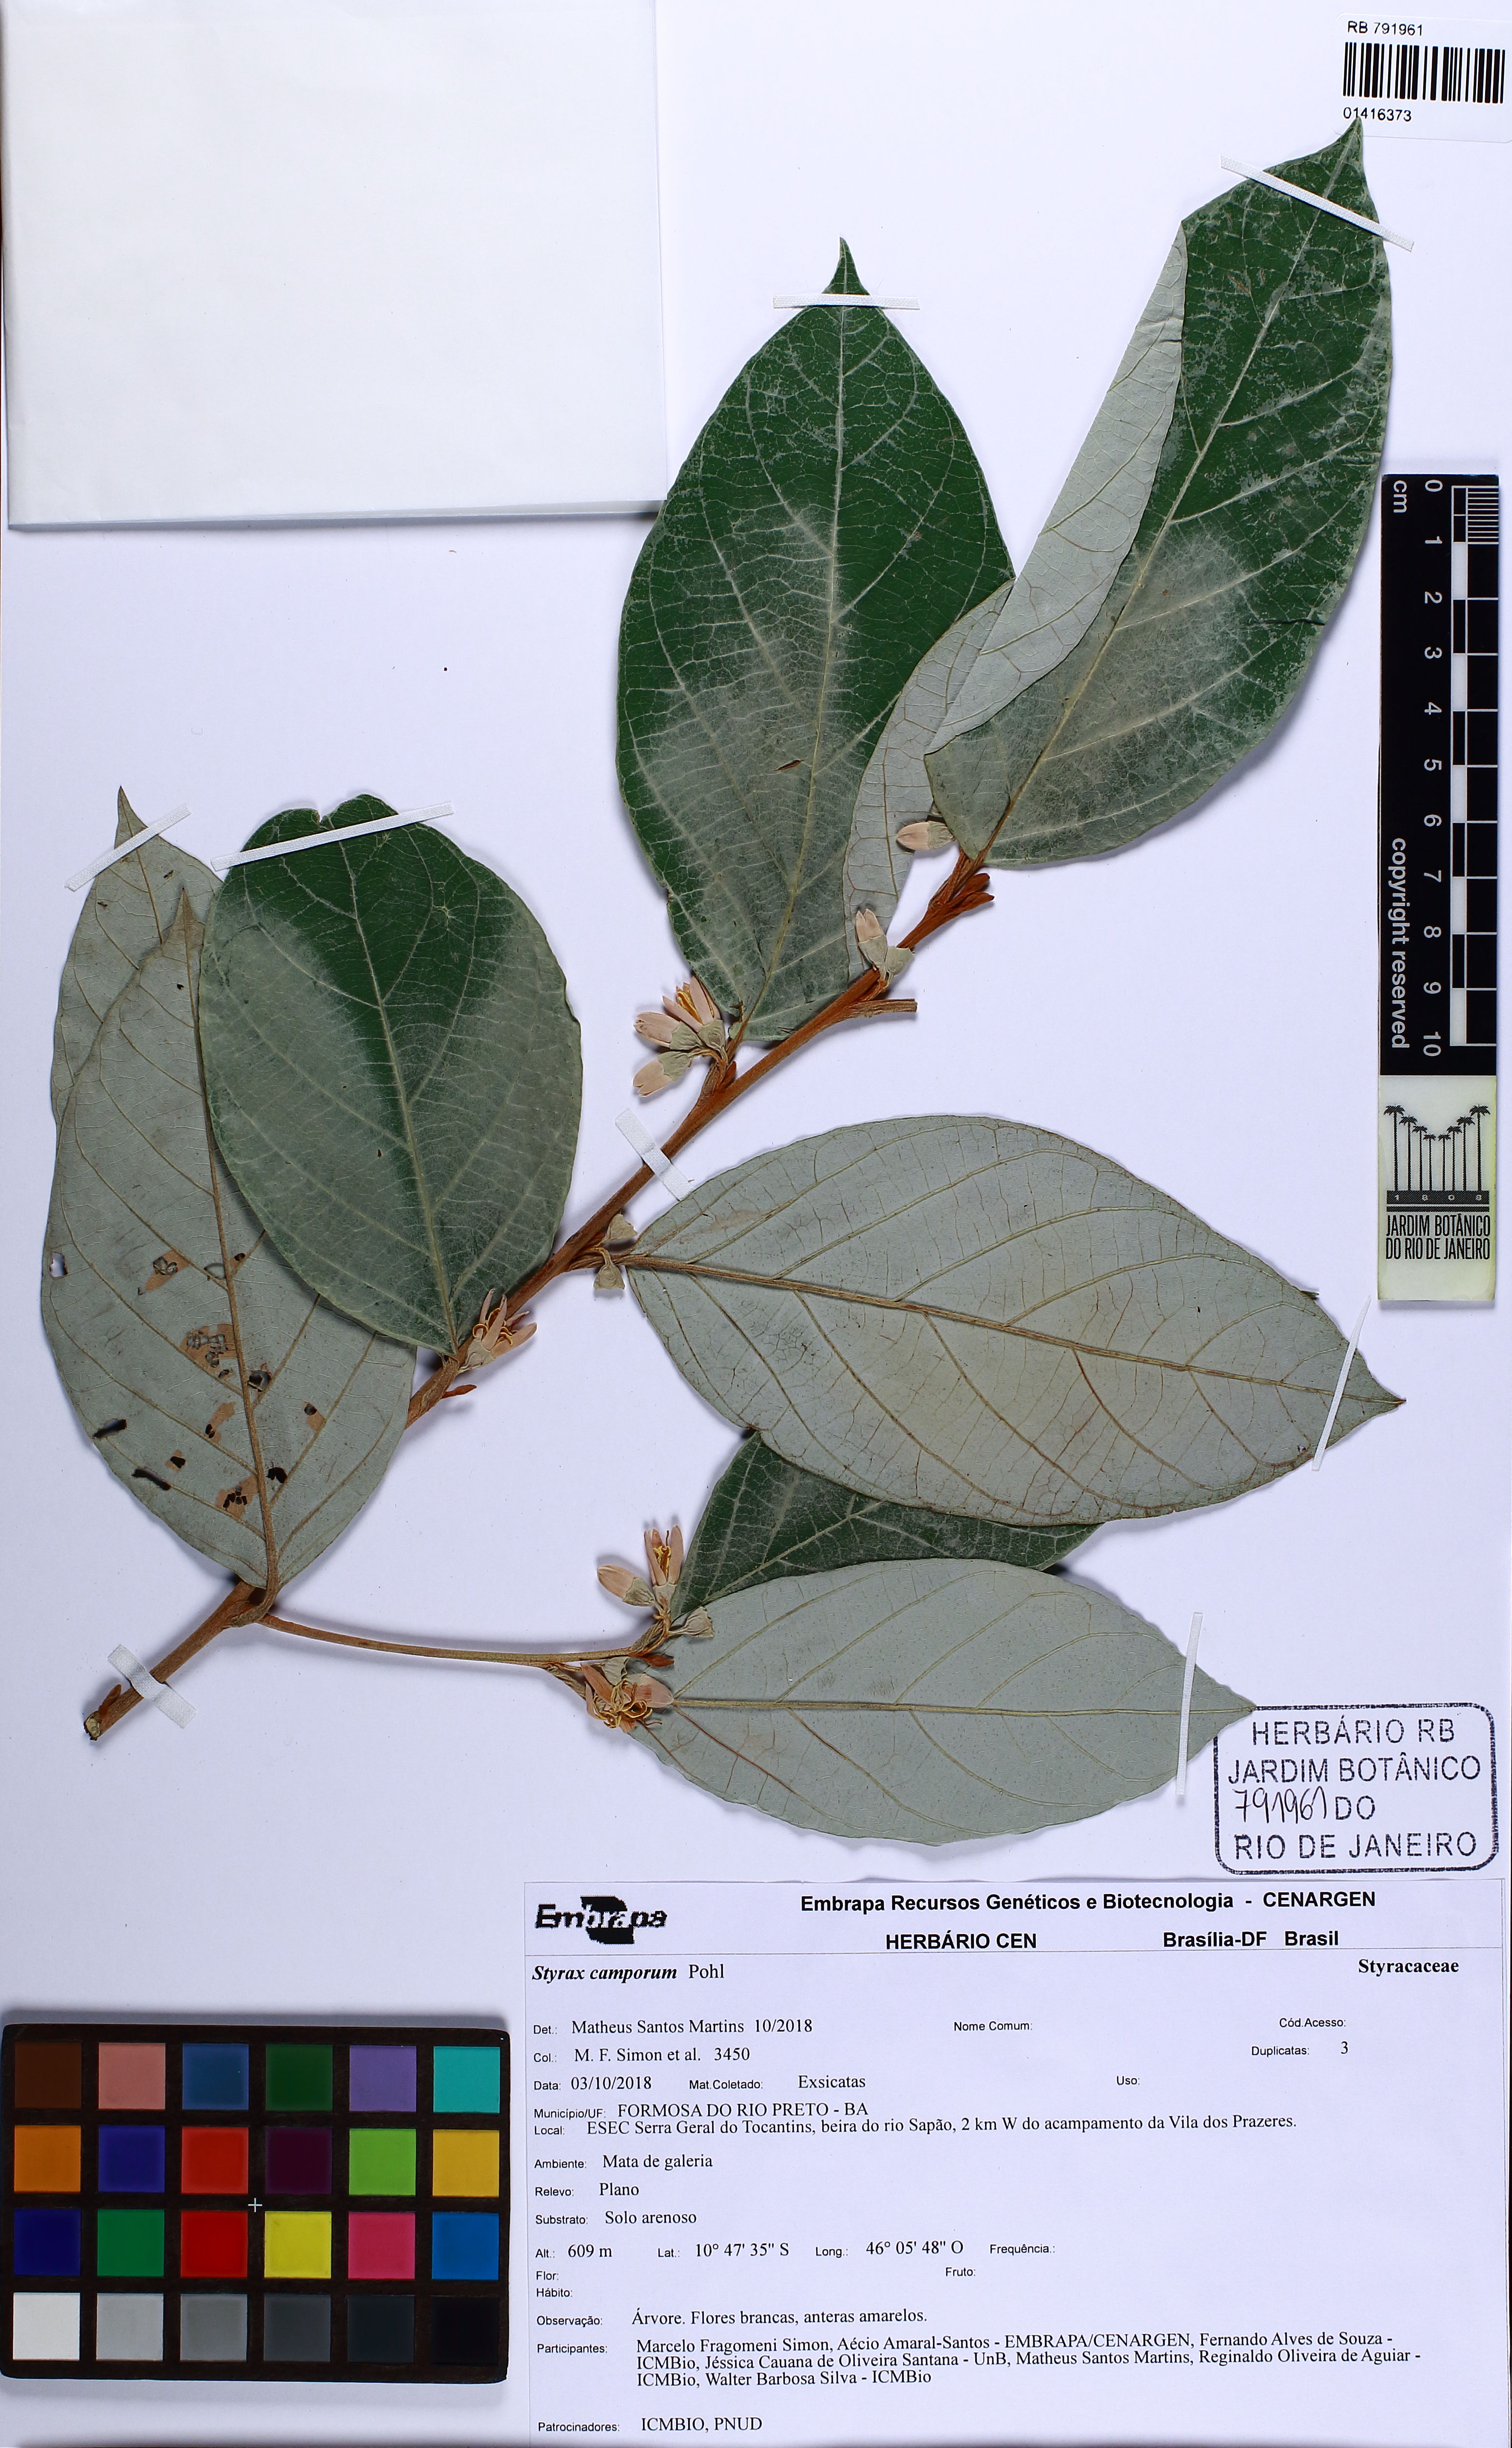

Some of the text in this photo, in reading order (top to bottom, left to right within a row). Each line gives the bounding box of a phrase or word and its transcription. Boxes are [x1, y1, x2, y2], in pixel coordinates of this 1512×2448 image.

[1348, 21, 1421, 36] RB 791961
[1343, 107, 1412, 122] 01416373
[1425, 480, 1443, 491] 0
[1394, 480, 1407, 512] cm
[1425, 591, 1442, 604] 2
[1425, 647, 1442, 659] 3
[1424, 702, 1442, 715] 4
[1424, 759, 1441, 771] 5
[1424, 815, 1442, 826] 6
[1424, 870, 1441, 882] 7
[1424, 926, 1441, 938] 8
[1388, 838, 1410, 1048] copyright reserved
[1424, 982, 1441, 994] 9
[1423, 1032, 1441, 1056] 10
[1386, 1213, 1490, 1237] JARDIM BOTÂNICO
[1386, 1237, 1490, 1259] DO RIO DE JANEIRO
[1252, 1715, 1455, 1745] HERBÁRIO RB
[1228, 1752, 1481, 1784] JARDIM BOTÂNICO
[1232, 1786, 1327, 1824] 791961
[1335, 1795, 1376, 1820] DO
[1234, 1831, 1477, 1860] RIO DE JANEIRO
[801, 1891, 1375, 1915] Embrapa Recursos Genéticos e Biotecnologia CENARGEN
[535, 1903, 667, 1929] Embrapa
[887, 1930, 1036, 1949] HERBÁRIO CEN
[1164, 1931, 1338, 1947] Brasília-DF Brasil
[532, 1963, 724, 1984] Styrax camporum Pohl
[1359, 1958, 1459, 1977] Styracaceae
[572, 2018, 812, 2034] Matheus Santos Martins 10/2018
[954, 2021, 1032, 2031] Nome Comum:
[1279, 2017, 1346, 2027] Cód.Acesso:
[534, 2025, 557, 2034] Det.:
[575, 2047, 750, 2061] M. F. Simon et al. 3450
[1252, 2046, 1309, 2057] Duplicatas:
[1341, 2041, 1348, 2054] 3
[534, 2053, 556, 2062] Col.:
[534, 2080, 561, 2090] Data:
[571, 2076, 651, 2090] 03/10/2018
[690, 2079, 763, 2089] Mat.Coletado:
[798, 2075, 865, 2088] Exsicatas
[1117, 2076, 1140, 2085] Uso:
[534, 2108, 605, 2120] Município/UF:
[618, 2102, 868, 2117] FORMOSA DO RIO PRETO BA
[535, 2125, 564, 2135] Local:
[587, 2115, 1296, 2135] ESEC Serra Geral do Tocantins, beira do rio Sapão, 2 km W do acampamento da Vila dos Prazeres.
[534, 2159, 586, 2168] Ambiente:
[603, 2154, 713, 2171] Mata de galeria
[535, 2187, 574, 2196] Relevo:
[600, 2182, 639, 2195] Plano
[536, 2214, 588, 2224] Substrato:
[605, 2210, 697, 2224] Solo arenoso
[535, 2249, 555, 2258] Alt.:
[568, 2244, 612, 2257] 609 m
[658, 2248, 679, 2257] Lat.:
[816, 2246, 848, 2258] Long.:
[990, 2243, 1055, 2256] Frequência.:
[537, 2271, 558, 2280] Flor:
[946, 2267, 975, 2276] Fruto:
[537, 2288, 572, 2297] Hábito:
[537, 2316, 602, 2328] Observação:
[632, 2307, 927, 2326] Árvore. Flores brancas, anteras amarelos.
[538, 2343, 607, 2355] Participantes:
[637, 2331, 1382, 2355] Marcelo Fragomeni Simon, Aécio Amaral-Santos EMBRAPA/CENARGEN, Fernando Alves de Souza
[637, 2348, 1411, 2371] ICMBio, Jéssica Cauana de Oliveira Santana UnB, Matheus Santos Martins, Reginaldo Oliveira de Aguiar
[638, 2369, 931, 2388] ICMBio, Walter Barbosa Silva ICMBio
[539, 2422, 619, 2431] Patrocinadores:
[641, 2417, 762, 2433] ICMBIO, PNUD
